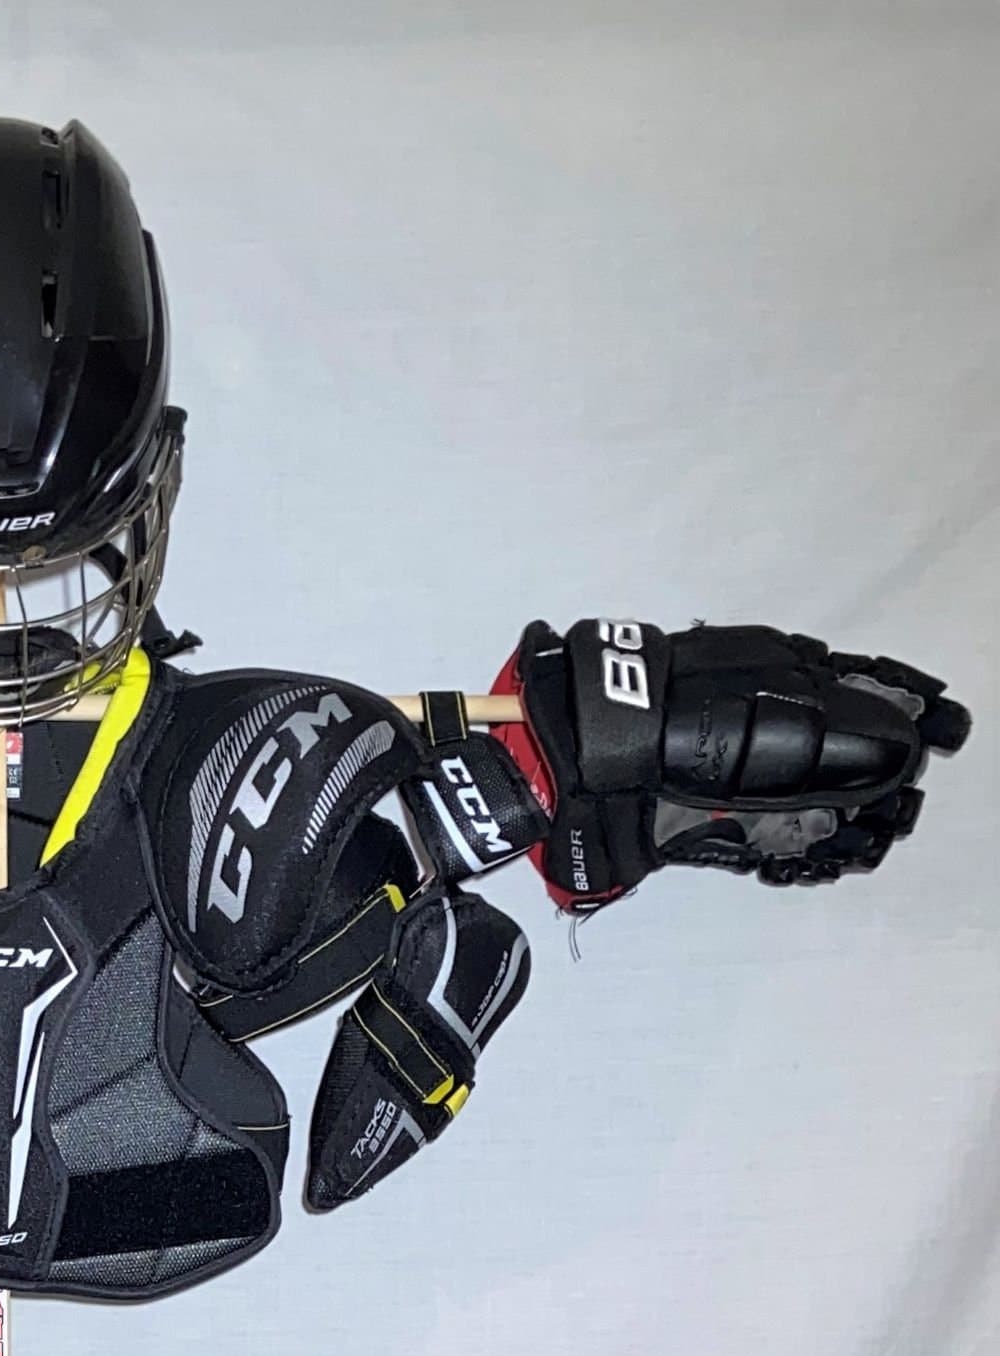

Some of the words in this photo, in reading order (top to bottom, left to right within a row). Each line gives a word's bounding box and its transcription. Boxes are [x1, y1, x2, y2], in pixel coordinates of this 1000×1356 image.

[206, 692, 353, 924] CCM
[440, 755, 513, 853] CCM
[570, 828, 589, 891] BAUER
[351, 1097, 386, 1160] TACKS
